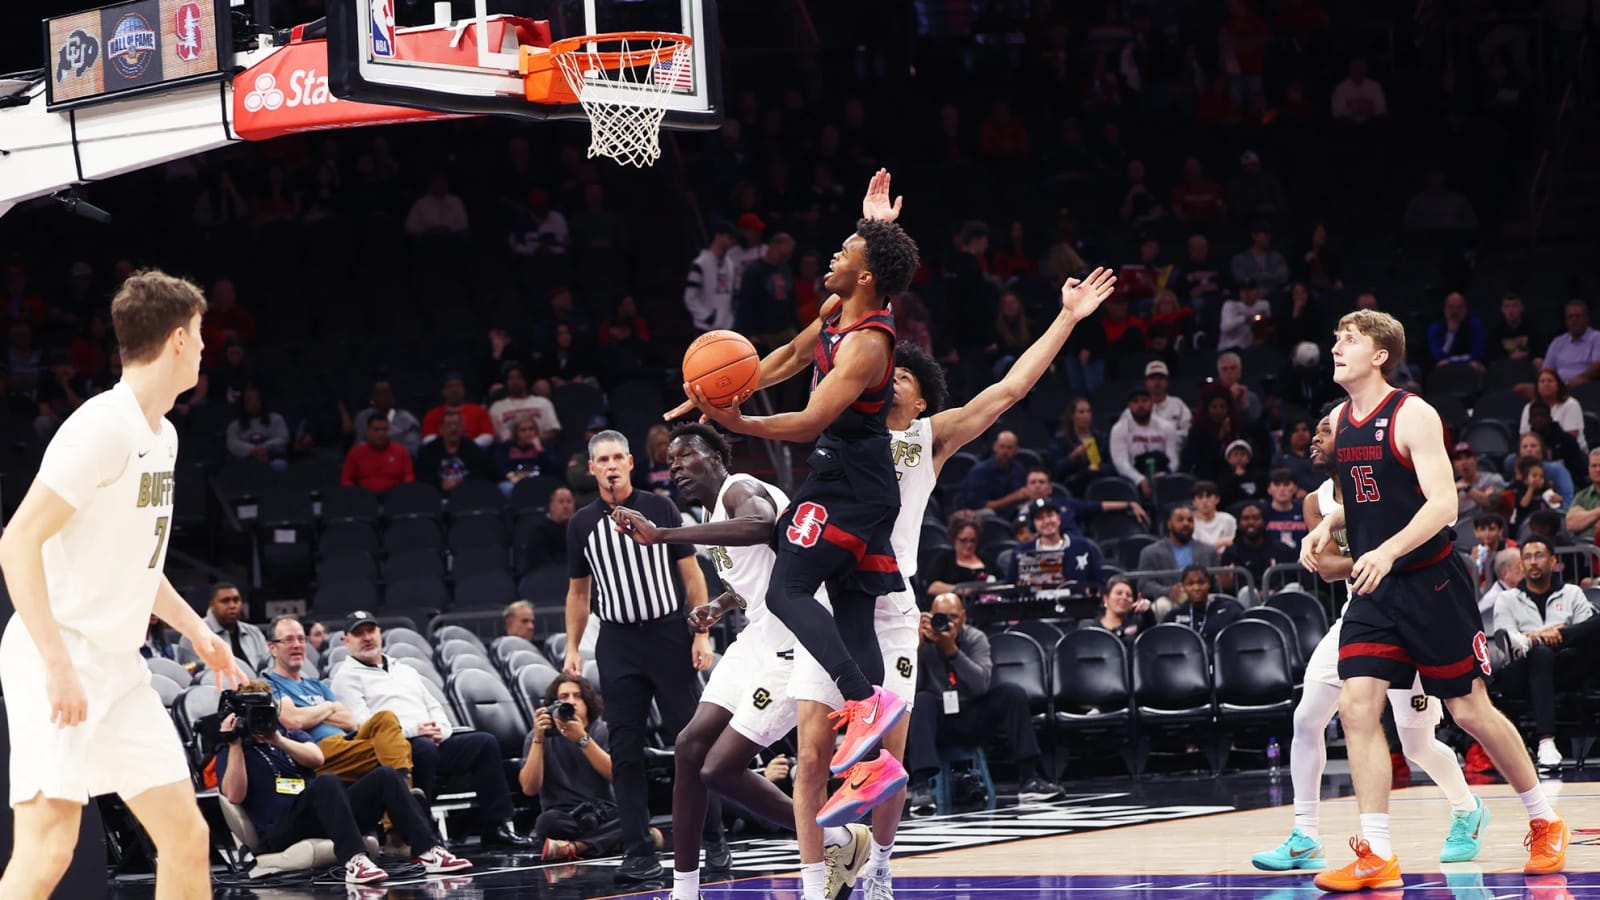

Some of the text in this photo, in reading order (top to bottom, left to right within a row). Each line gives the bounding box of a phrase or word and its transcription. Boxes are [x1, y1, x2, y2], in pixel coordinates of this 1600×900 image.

[110, 36, 127, 54] HALL
[135, 32, 153, 49] FAME
[375, 39, 388, 52] NBA
[286, 68, 338, 107] Sta
[1337, 445, 1383, 462] STANFORD
[1351, 465, 1381, 503] 15
[148, 516, 169, 569] 7
